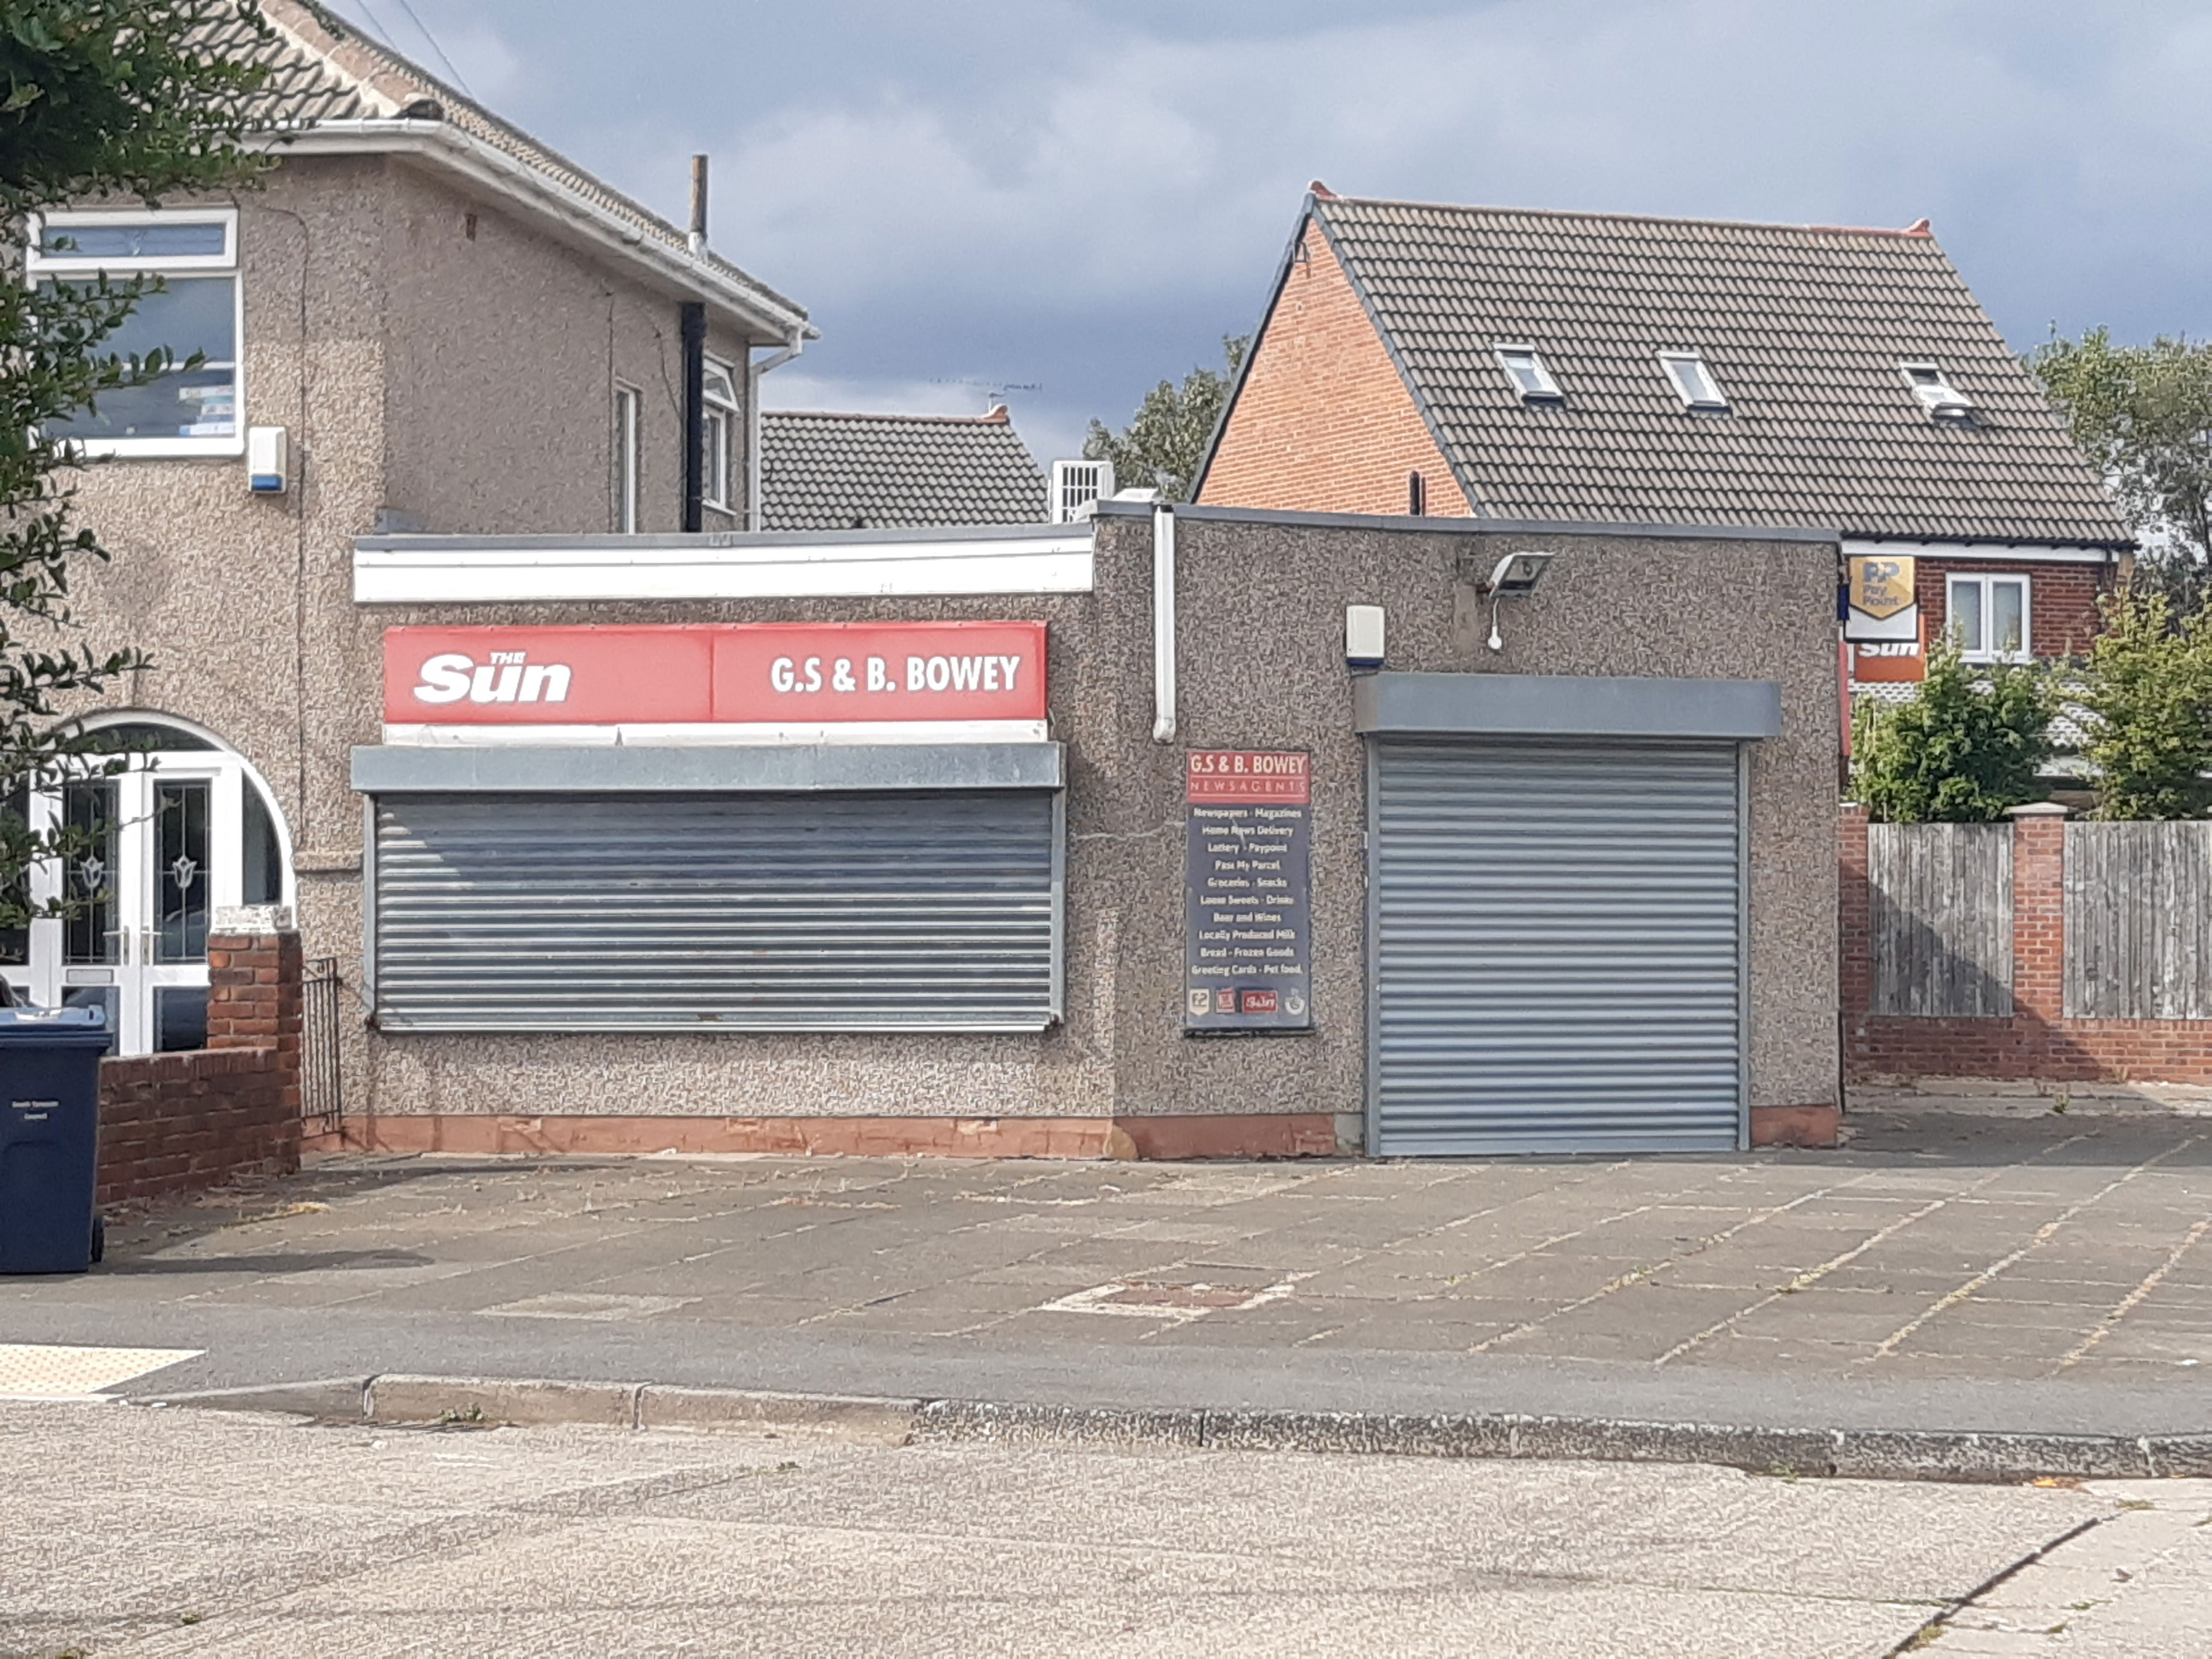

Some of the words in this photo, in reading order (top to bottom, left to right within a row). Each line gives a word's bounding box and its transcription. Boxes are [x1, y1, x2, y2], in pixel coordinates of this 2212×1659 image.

[1864, 596, 1898, 606] Point
[490, 652, 526, 664] THE
[413, 653, 571, 703] Sun
[771, 657, 822, 692] G.S
[832, 658, 856, 692] &
[867, 657, 896, 691] B.
[907, 656, 1020, 691] BOWEY
[1191, 755, 1214, 773] G.S
[1218, 755, 1230, 773] &
[1234, 755, 1249, 773] B.
[1253, 755, 1305, 774] BOWEY
[1191, 782, 1305, 792] NEWSAGENTS
